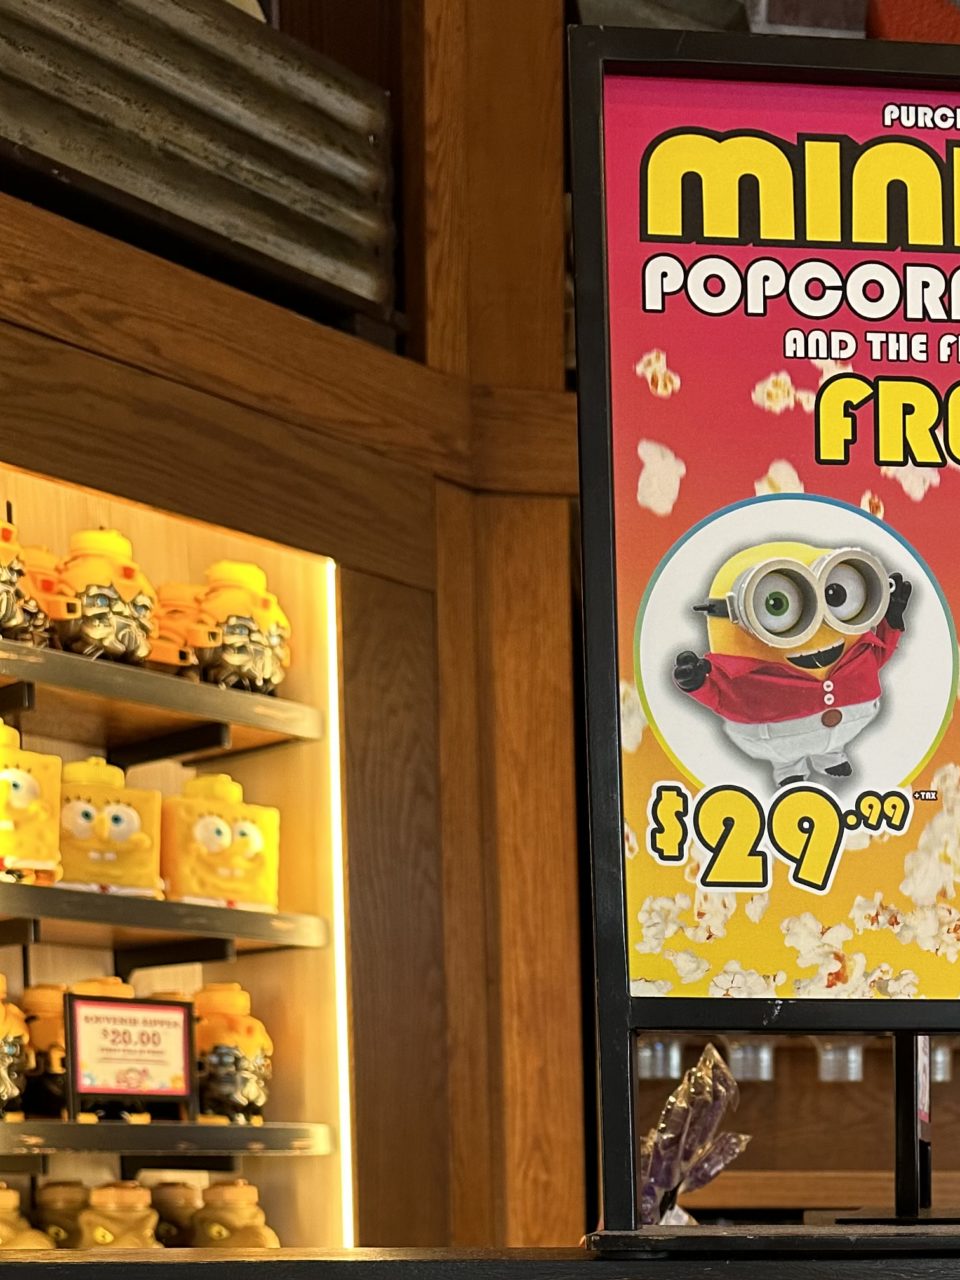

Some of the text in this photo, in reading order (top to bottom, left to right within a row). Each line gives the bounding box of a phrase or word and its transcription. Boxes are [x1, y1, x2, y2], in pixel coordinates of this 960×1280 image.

[785, 331, 856, 360] AND
[866, 332, 928, 362] THE
[102, 1028, 161, 1047] $20.00
